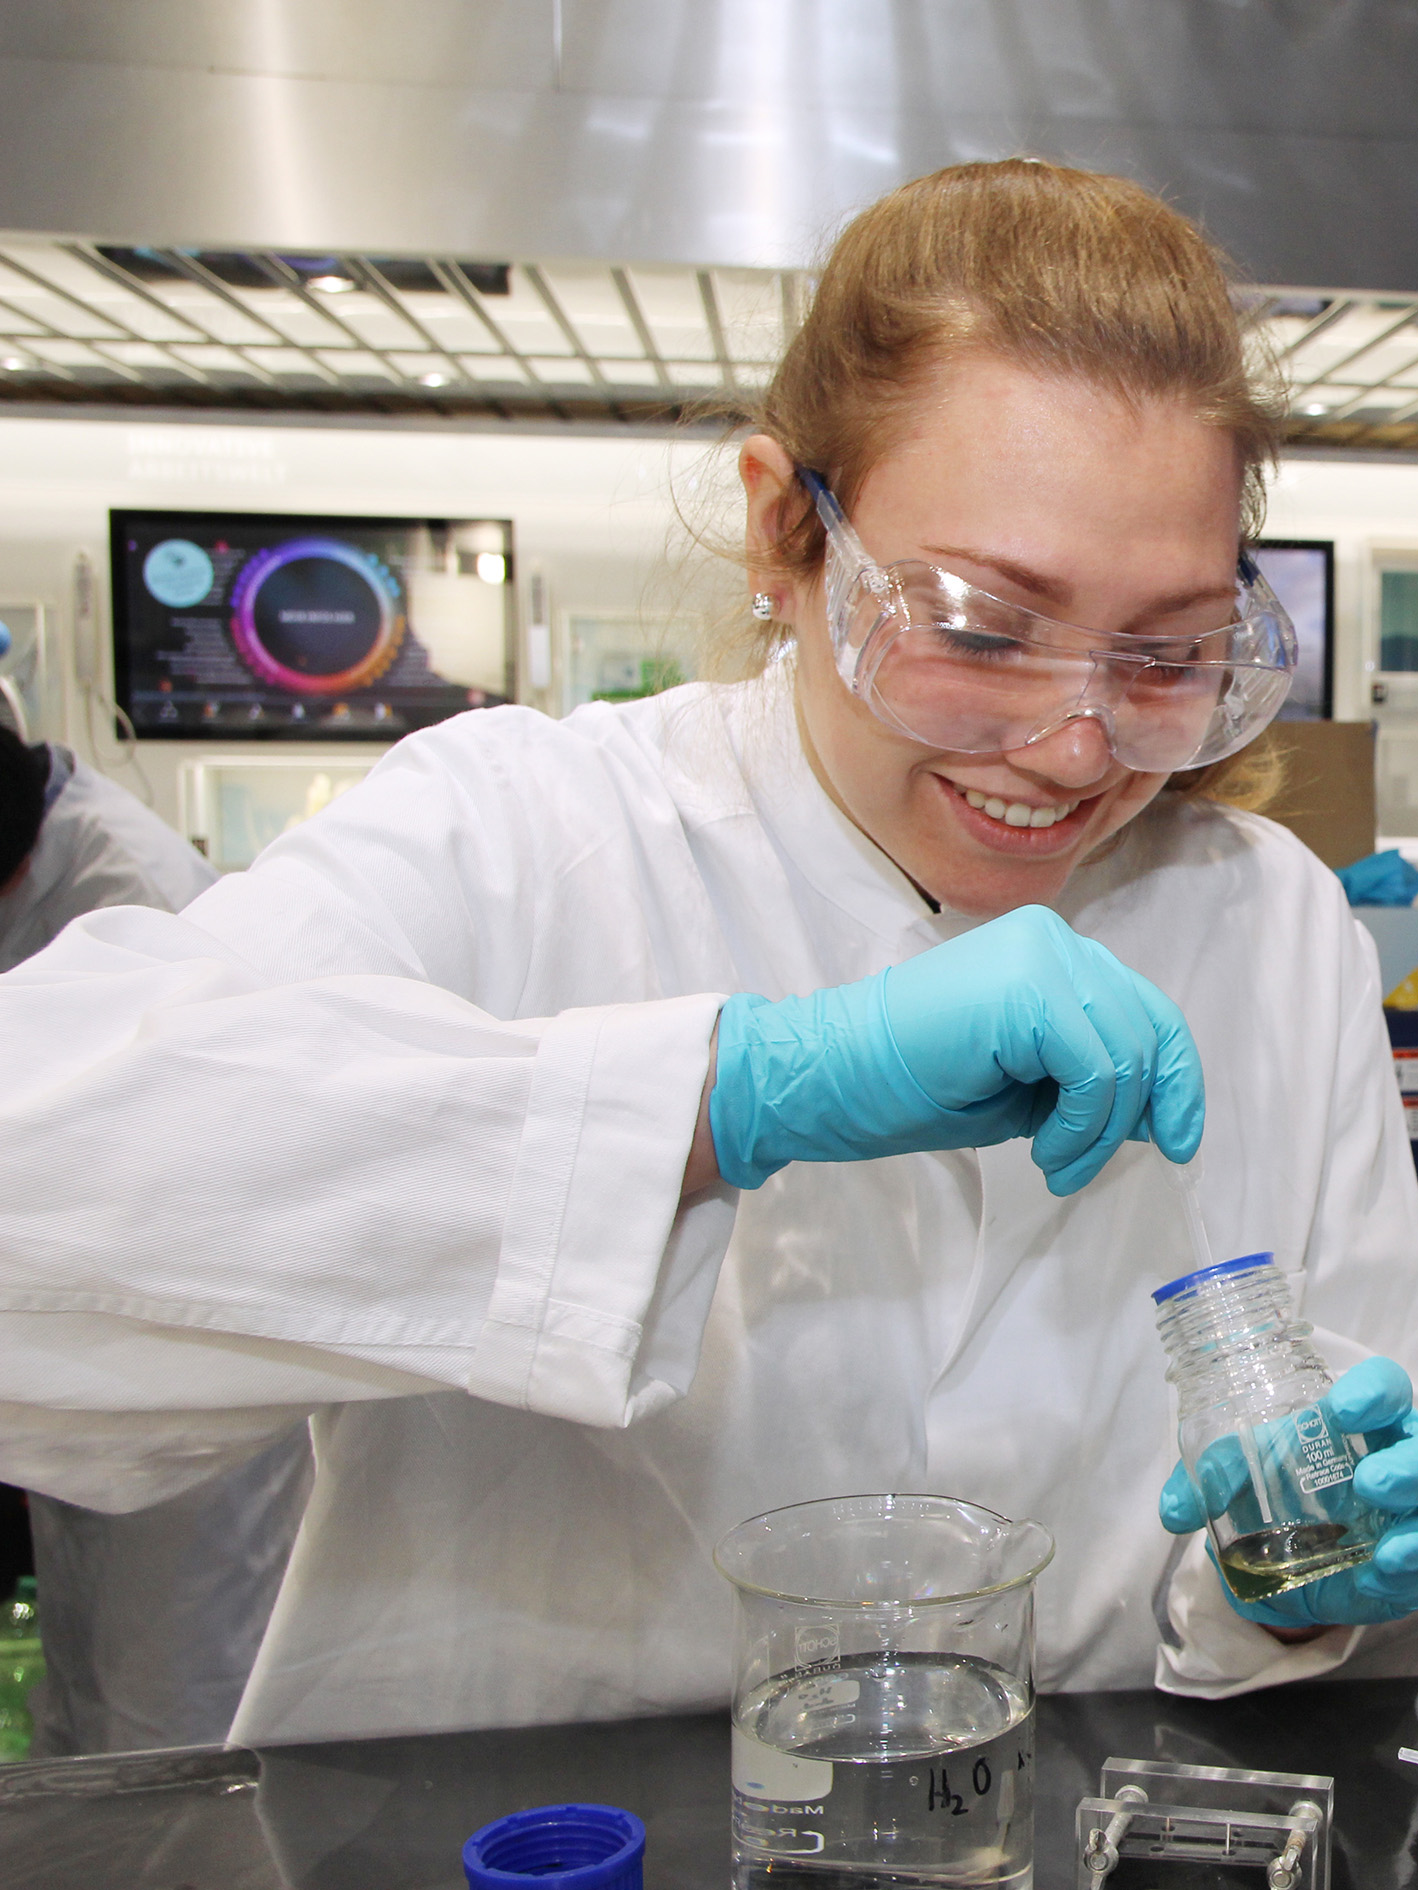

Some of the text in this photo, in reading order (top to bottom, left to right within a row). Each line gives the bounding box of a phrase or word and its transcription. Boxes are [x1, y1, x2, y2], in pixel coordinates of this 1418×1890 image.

[1302, 1437, 1333, 1454] DURAN
[1306, 1447, 1335, 1464] 100 ml
[1295, 1464, 1315, 1477] Made
[1315, 1461, 1323, 1469] in
